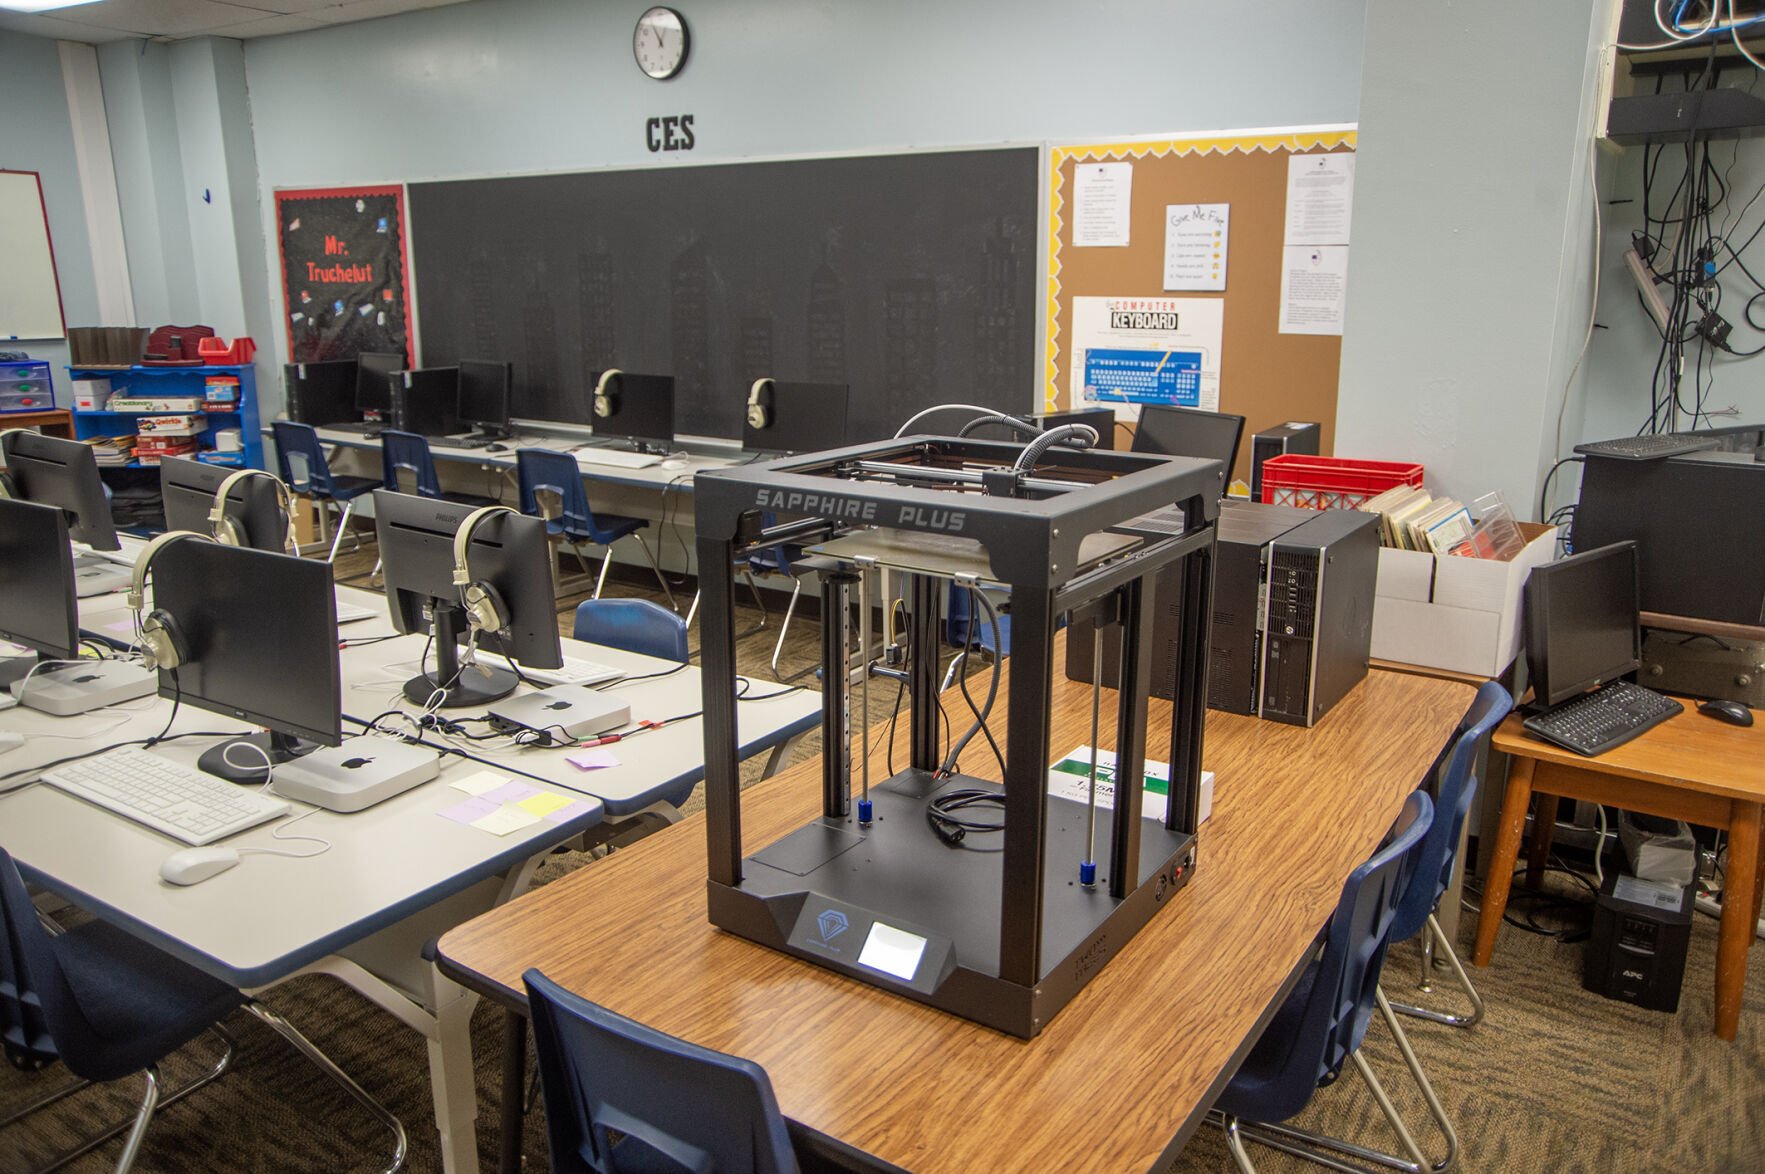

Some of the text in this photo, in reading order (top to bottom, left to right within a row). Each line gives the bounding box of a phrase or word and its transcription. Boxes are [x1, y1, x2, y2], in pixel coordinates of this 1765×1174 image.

[646, 114, 694, 152] CES
[324, 234, 349, 256] Mr.
[306, 261, 373, 283] Truchelut
[1115, 301, 1175, 311] COMPUTER
[1112, 312, 1177, 330] KEYBOARD
[755, 489, 966, 531] SAPPHIRE PLUS
[1622, 969, 1644, 980] APC
